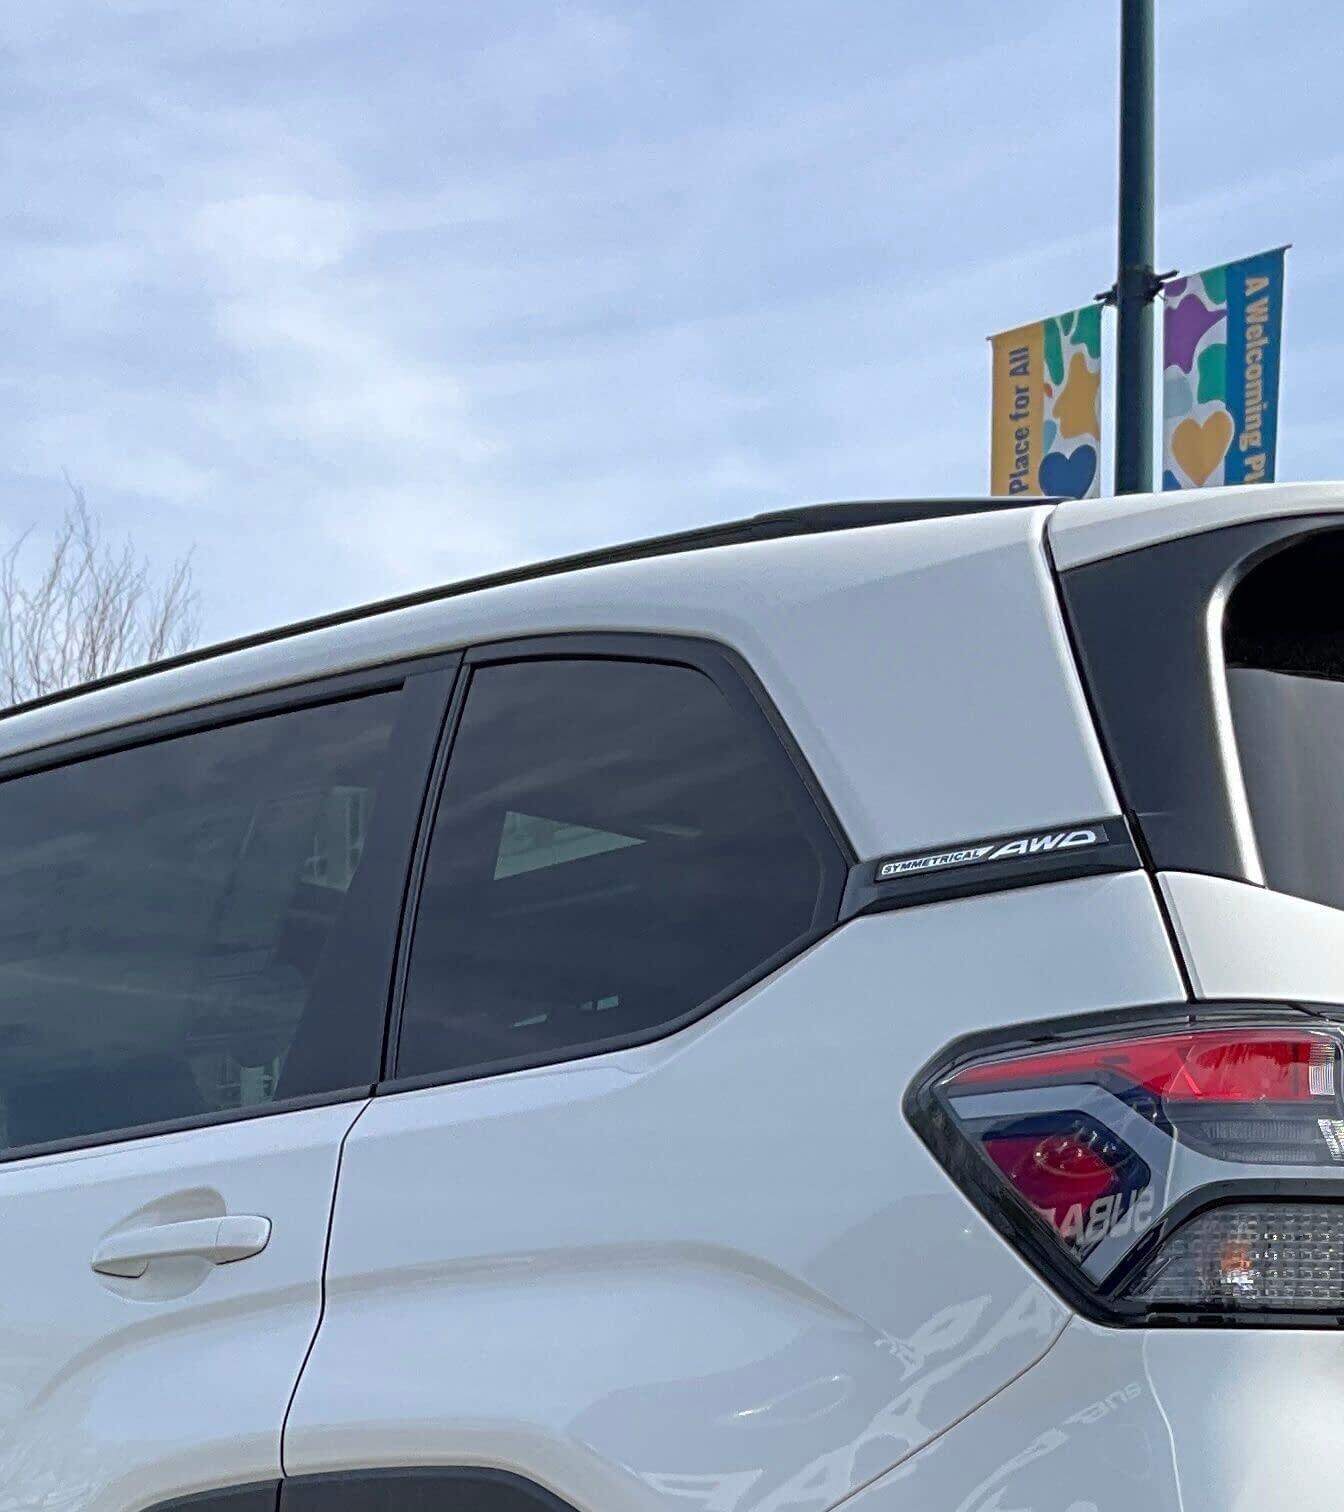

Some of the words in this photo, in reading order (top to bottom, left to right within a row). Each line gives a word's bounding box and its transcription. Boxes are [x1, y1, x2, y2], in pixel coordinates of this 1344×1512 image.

[1245, 276, 1269, 296] A
[1009, 346, 1030, 378] All
[1239, 297, 1269, 452] Welcoming
[1009, 384, 1030, 422] for
[1009, 427, 1030, 495] Place
[881, 848, 982, 875] SYMMETRICAL
[989, 830, 1098, 860] AWD
